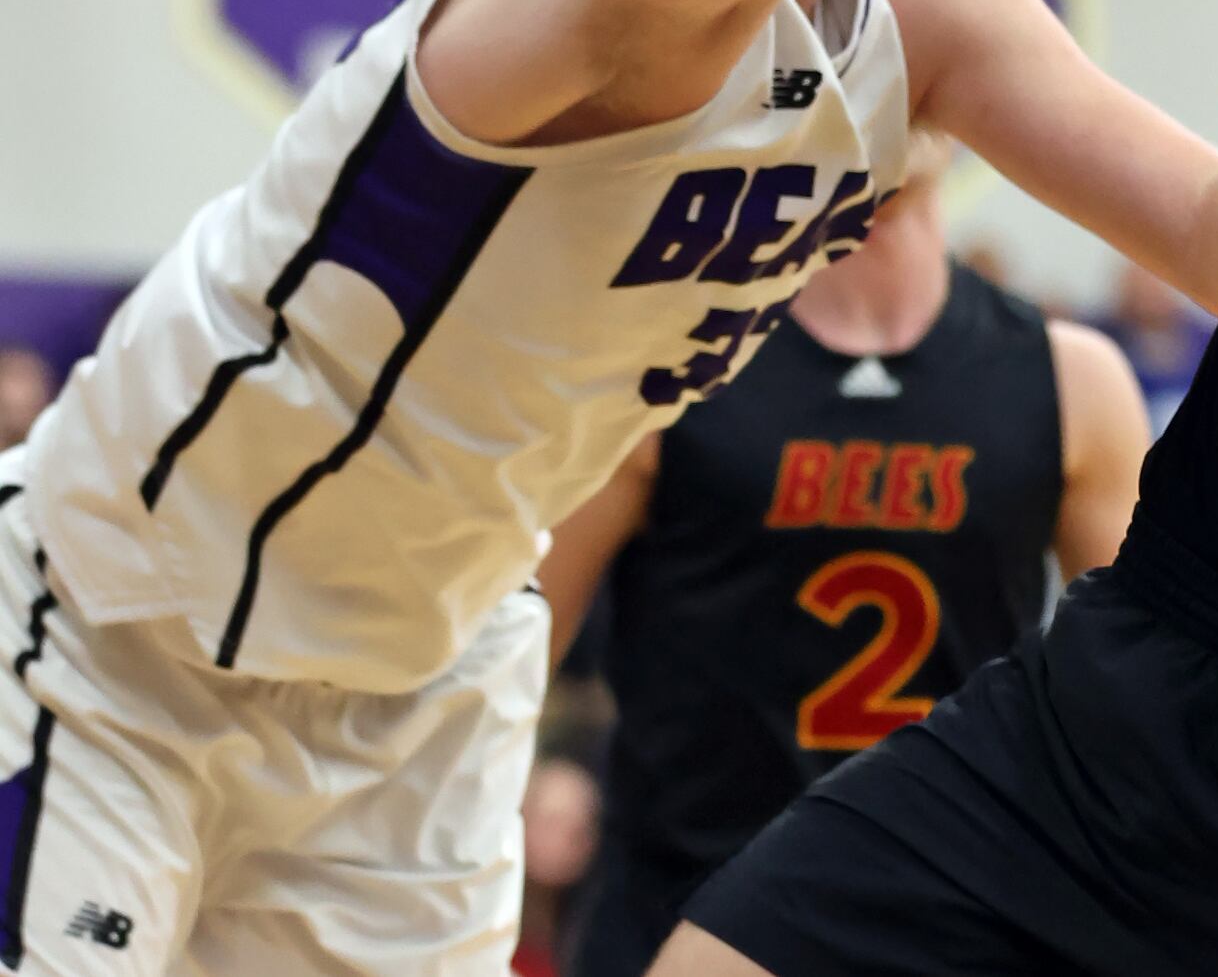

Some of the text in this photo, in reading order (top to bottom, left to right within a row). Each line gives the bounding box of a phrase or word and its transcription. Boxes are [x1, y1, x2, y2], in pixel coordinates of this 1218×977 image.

[640, 302, 790, 406] 3
[764, 438, 976, 533] BEES
[796, 550, 941, 751] 2
